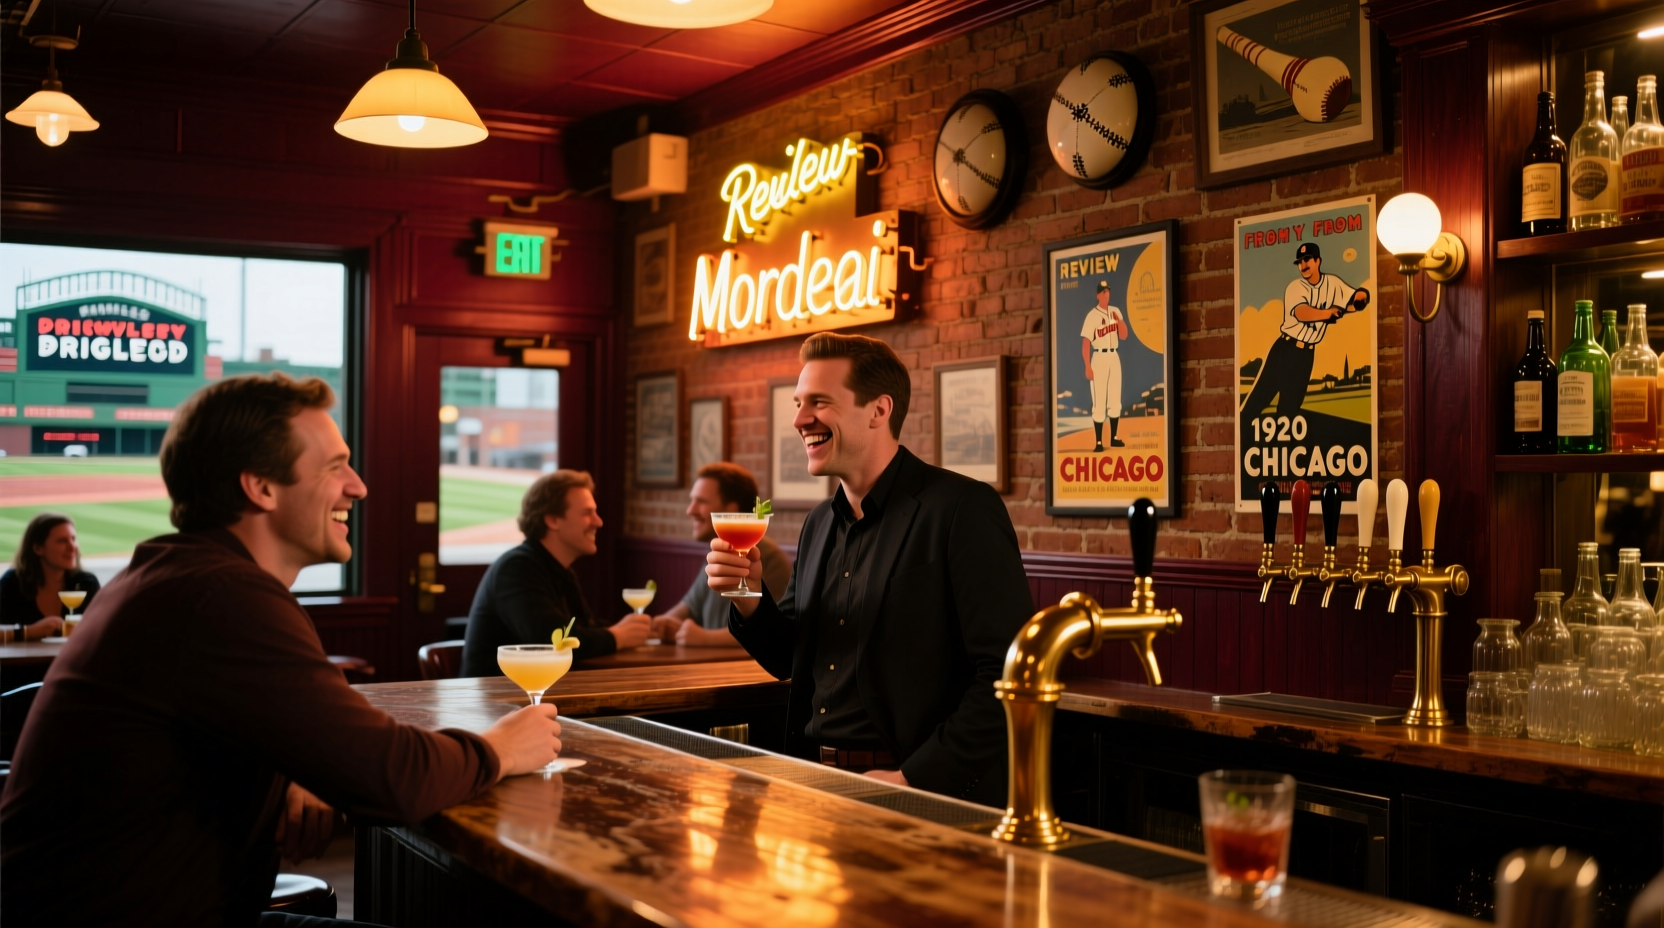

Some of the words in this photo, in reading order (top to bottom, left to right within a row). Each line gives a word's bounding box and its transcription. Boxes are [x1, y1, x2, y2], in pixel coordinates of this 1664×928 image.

[1060, 253, 1120, 280] REVIEW
[1251, 415, 1308, 443] 1920
[1060, 454, 1164, 483] CHICAGO
[1244, 444, 1368, 477] CHICAGO
